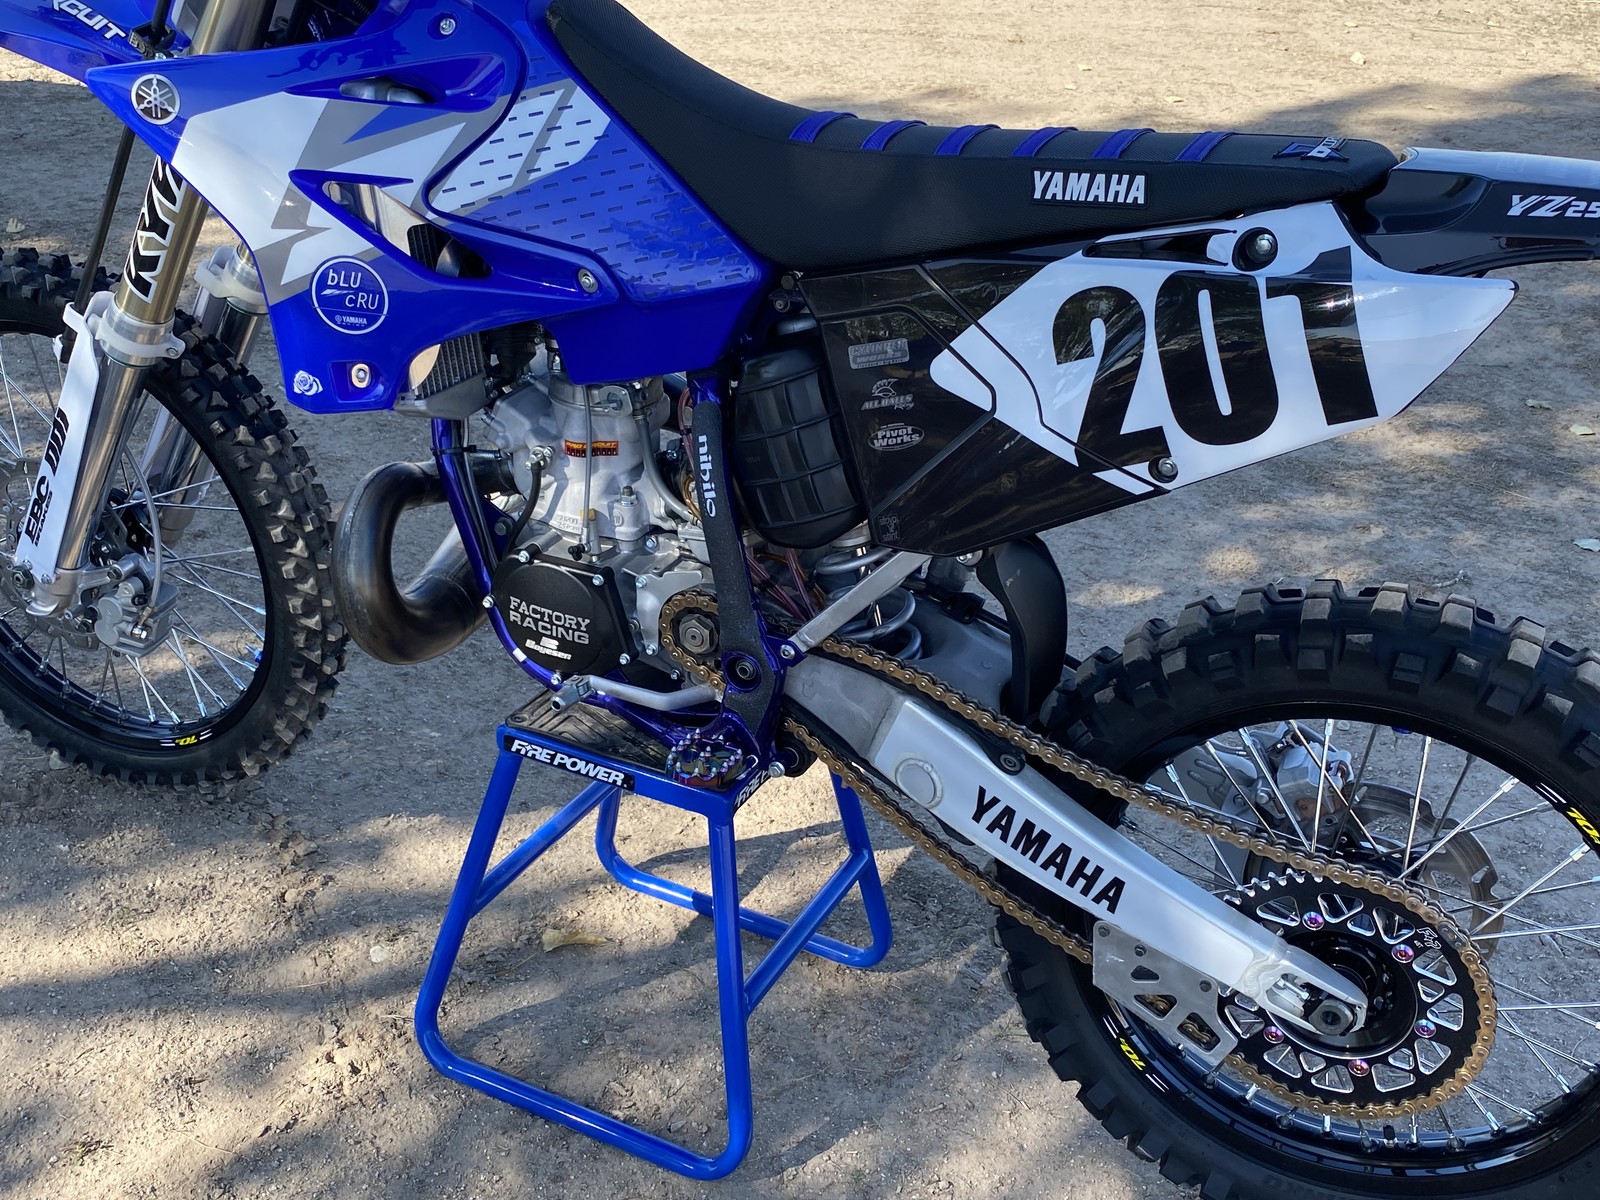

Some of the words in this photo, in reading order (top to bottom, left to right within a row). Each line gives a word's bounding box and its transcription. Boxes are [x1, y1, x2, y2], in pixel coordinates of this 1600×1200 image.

[1033, 170, 1146, 204] YAMAHA
[342, 315, 367, 325] YAMAHA
[1052, 245, 1379, 472] 201
[873, 433, 920, 448] Works
[24, 475, 50, 545] EBC
[509, 595, 591, 632] FACTORY
[509, 609, 590, 645] RACING
[510, 739, 556, 764] FIRE
[553, 751, 626, 787] POWER
[971, 784, 1127, 915] YAMAHA
